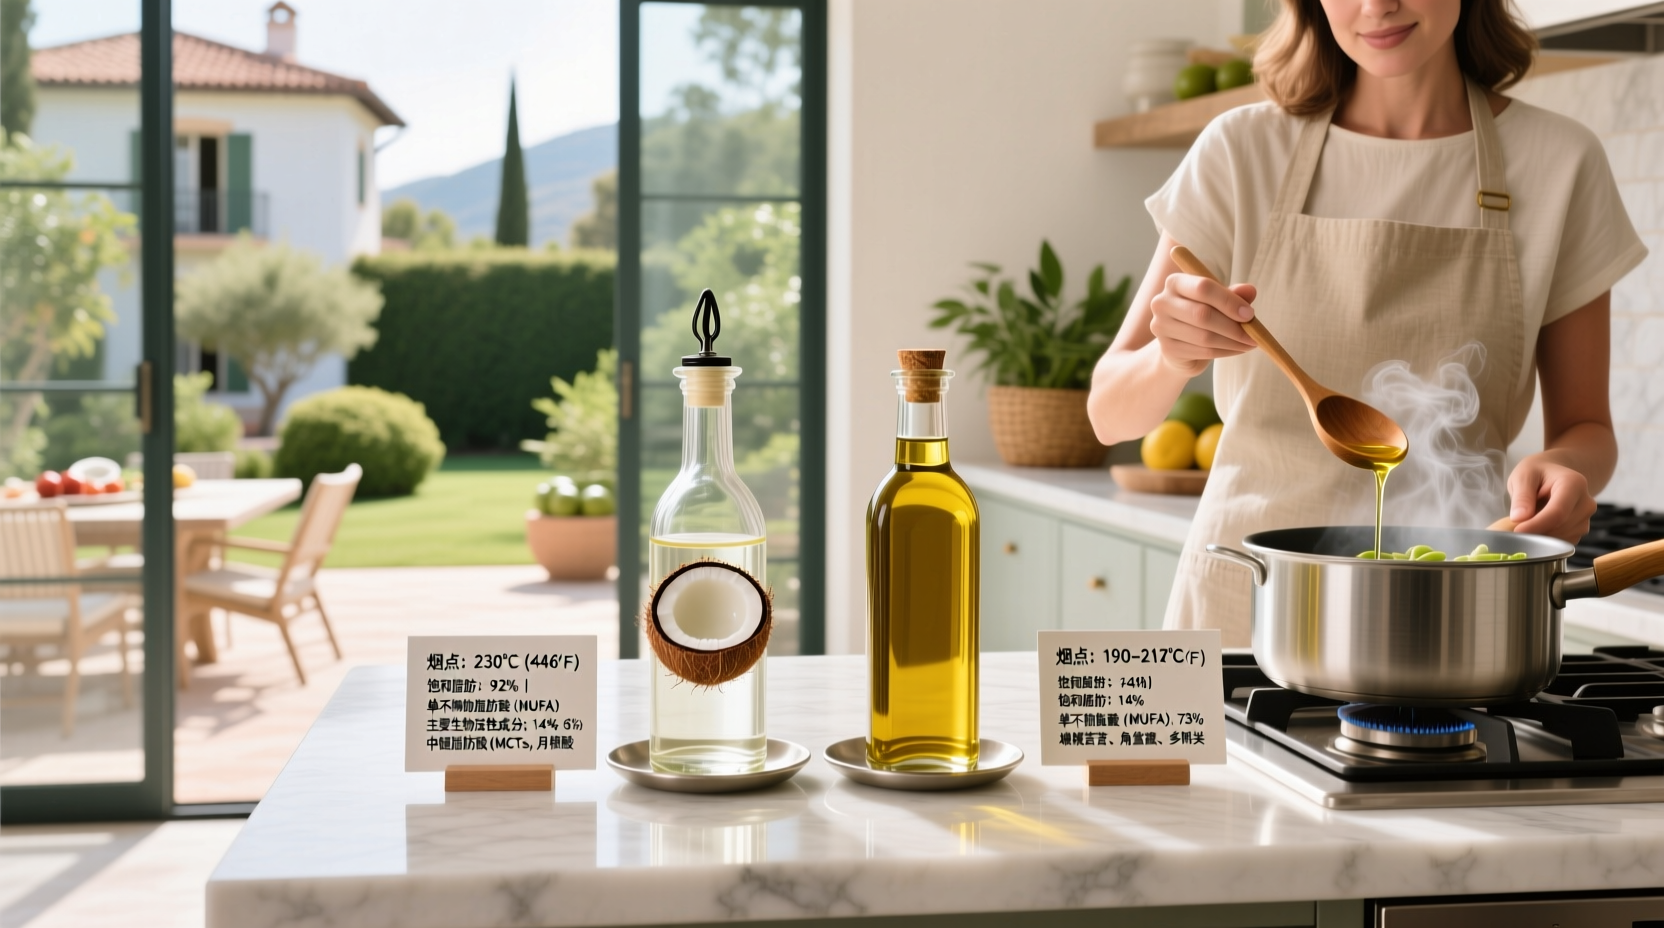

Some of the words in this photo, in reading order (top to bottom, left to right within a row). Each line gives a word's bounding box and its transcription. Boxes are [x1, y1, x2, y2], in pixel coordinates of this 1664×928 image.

[474, 653, 520, 669] 230°C
[490, 679, 519, 692] 92%
[1119, 694, 1145, 707] 14%
[1177, 712, 1204, 726] 73%
